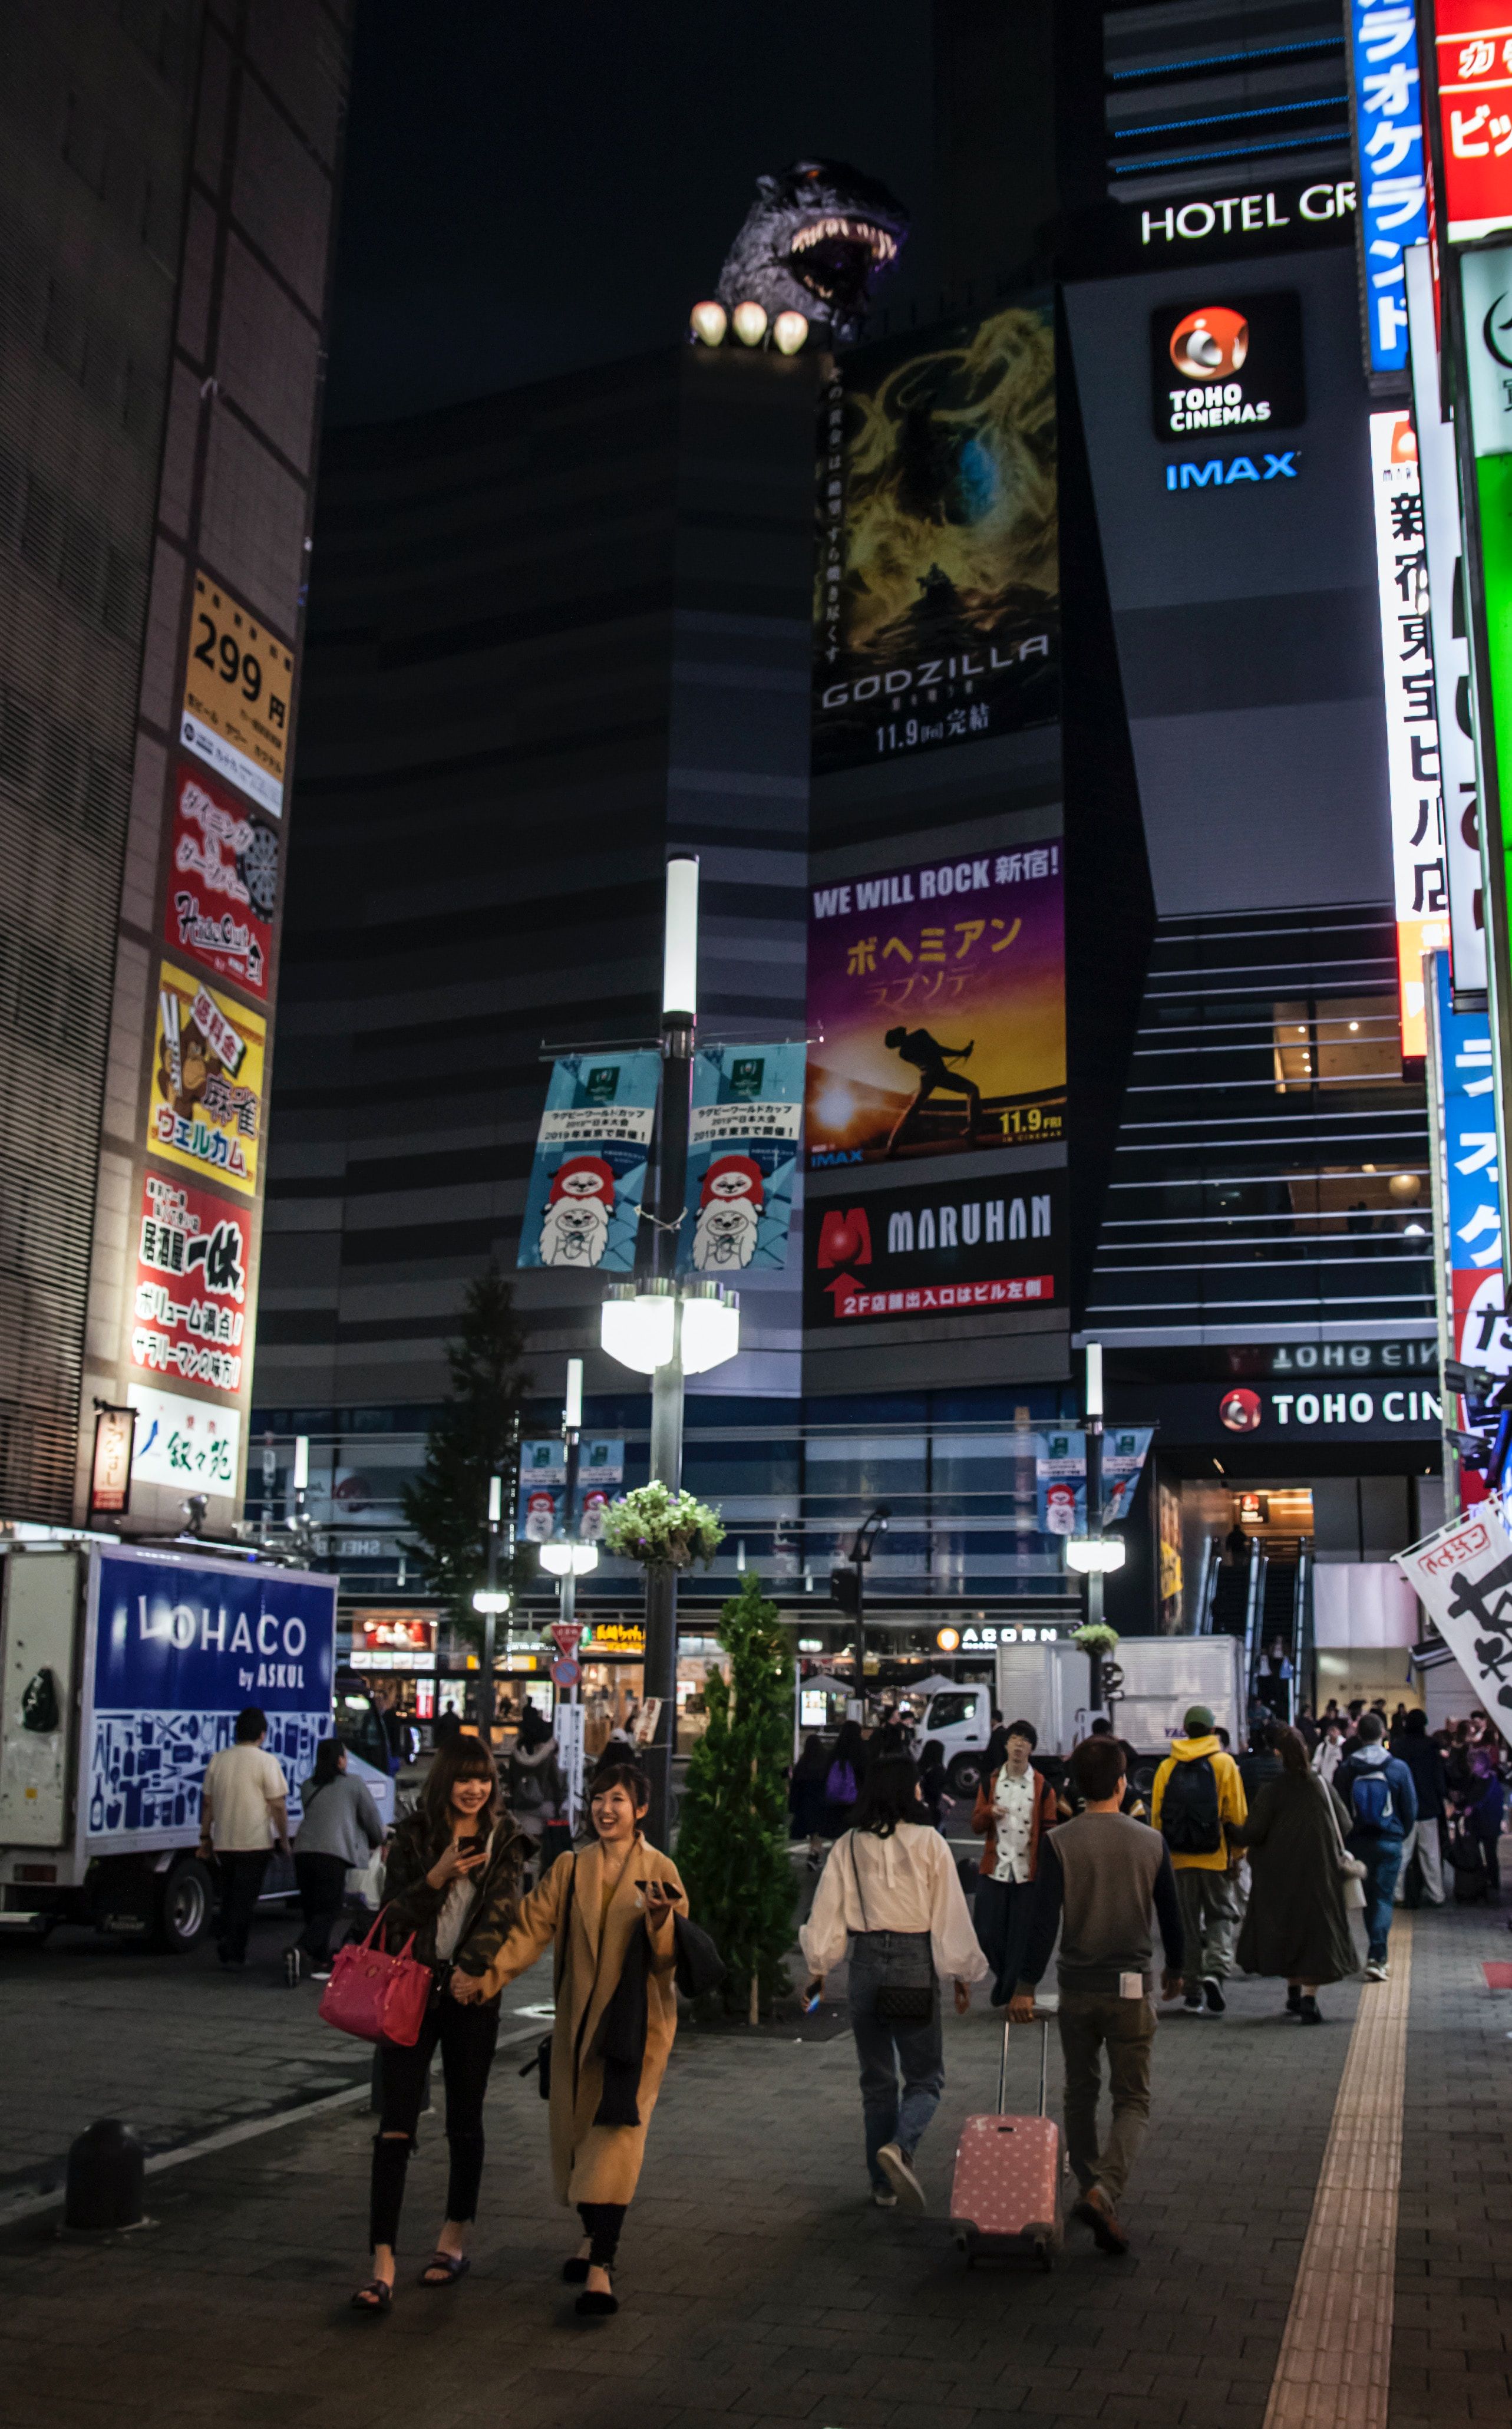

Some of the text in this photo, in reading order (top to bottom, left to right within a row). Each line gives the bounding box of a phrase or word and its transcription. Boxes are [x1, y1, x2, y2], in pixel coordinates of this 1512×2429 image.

[1357, 0, 1428, 351] ラオケランド
[1141, 193, 1290, 243] HOTEL
[1170, 383, 1242, 412] TOHO
[1170, 401, 1271, 432] CINEMAS
[1167, 451, 1296, 490] IMAX
[823, 634, 1049, 708] GODZILLA
[877, 719, 917, 752] 11.9
[947, 702, 990, 736] 完結
[813, 845, 1059, 919] WE WILL ROCK 新宿!
[846, 917, 1023, 976] ボヘミアン
[157, 1104, 247, 1176] ウェルカム
[999, 1109, 1042, 1135] 11.9
[811, 1150, 863, 1168] IMAX
[888, 1194, 1051, 1254] MARUHAN
[1272, 1390, 1444, 1424] TOHO CIN
[138, 1595, 306, 1656] LOHACO
[239, 1663, 305, 1692] by ASKUL
